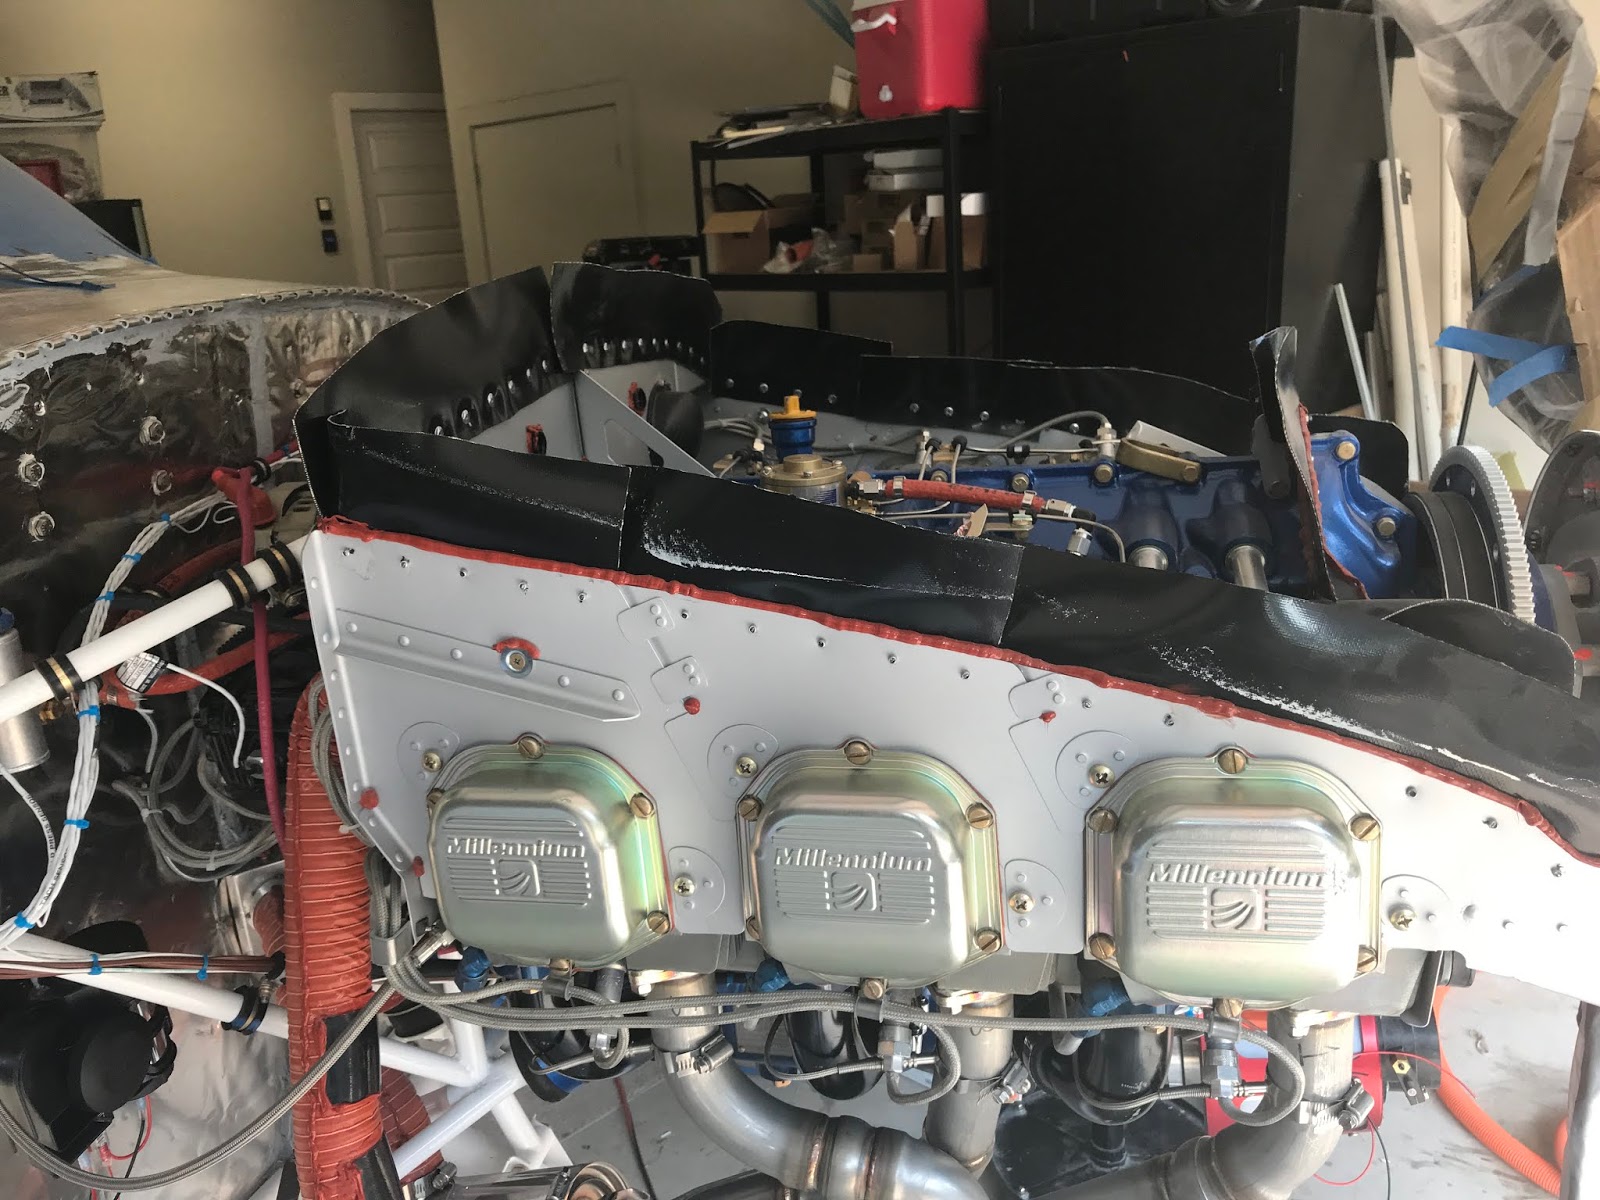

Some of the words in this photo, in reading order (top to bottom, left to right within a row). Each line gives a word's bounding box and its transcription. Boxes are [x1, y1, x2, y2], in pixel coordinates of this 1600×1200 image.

[44, 823, 55, 850] PRESS
[447, 837, 586, 858] Millennium
[774, 847, 932, 872] Millennium
[39, 882, 56, 906] TACH
[53, 846, 69, 881] SENSO
[1147, 862, 1327, 887] Millennium
